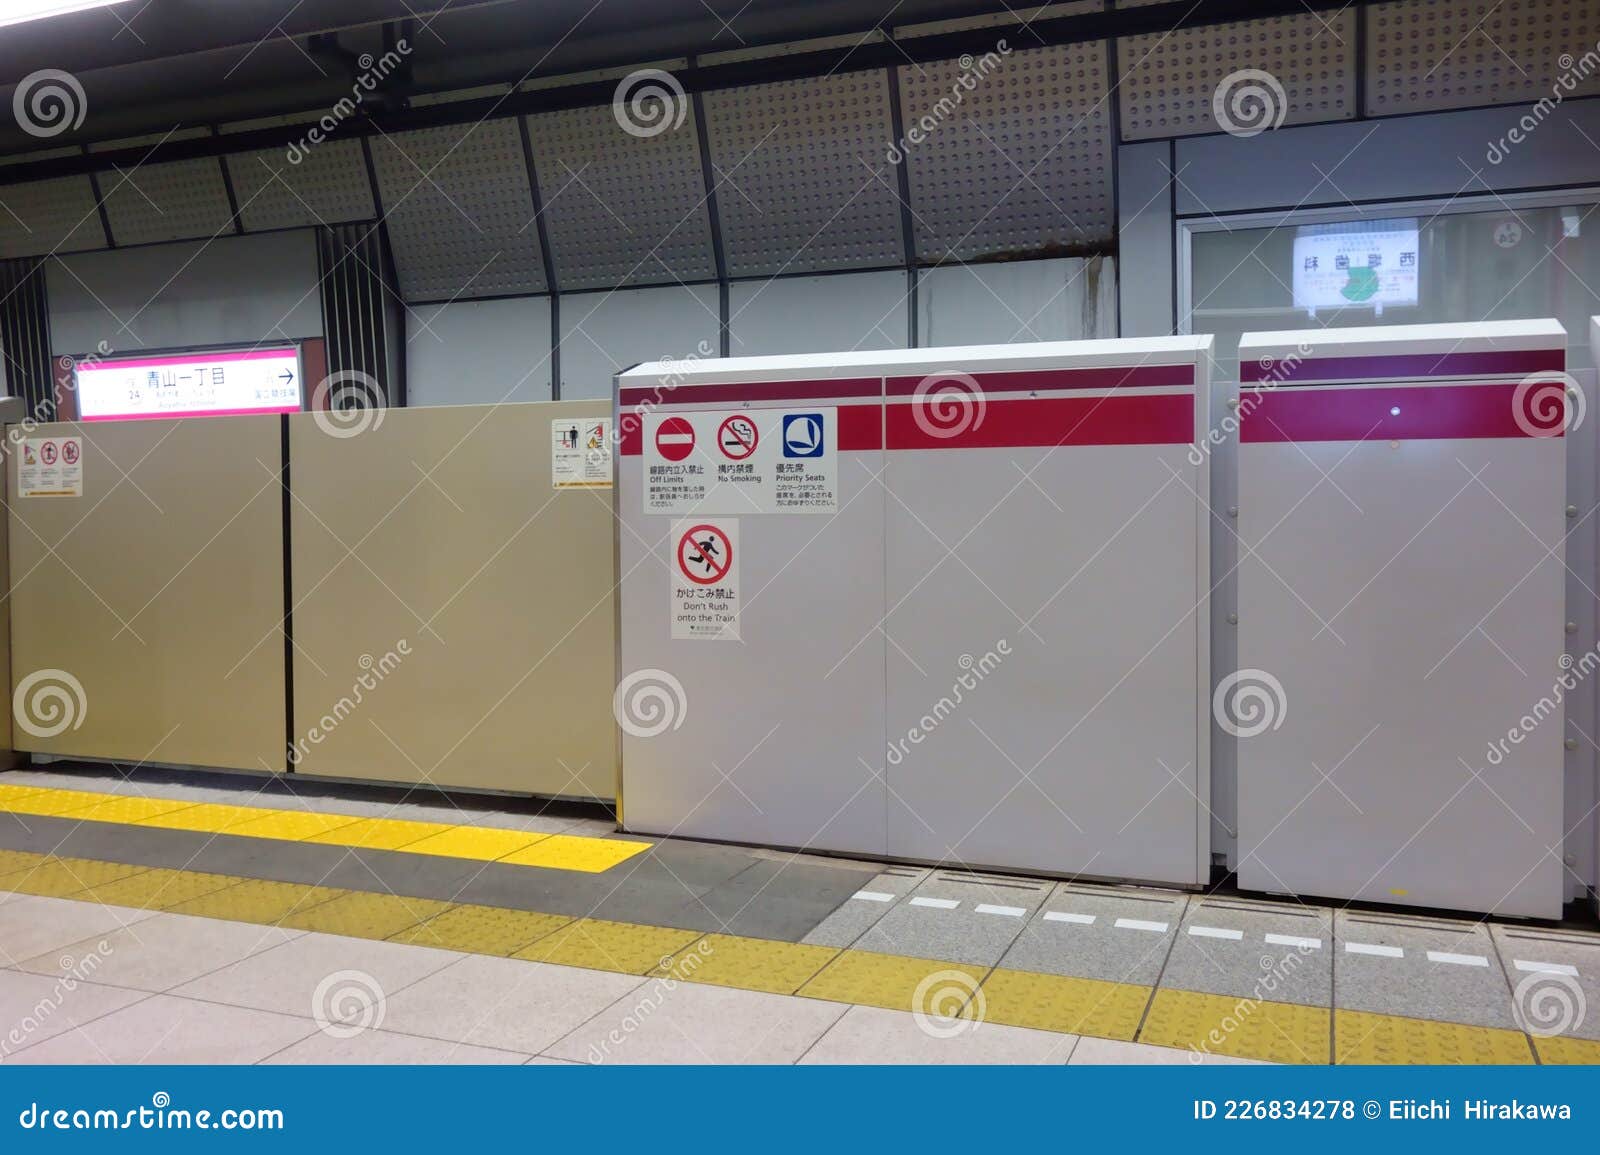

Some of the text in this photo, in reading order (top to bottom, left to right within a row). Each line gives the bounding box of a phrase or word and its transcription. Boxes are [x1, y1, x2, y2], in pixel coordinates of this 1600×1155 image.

[146, 367, 225, 389] 青山一丁目
[650, 464, 704, 475] 線路内立入禁止
[718, 463, 754, 474] 構内禁煙
[775, 463, 804, 473] 優先席
[650, 475, 684, 483] Off Limits
[731, 475, 762, 483] Smoking
[775, 474, 825, 483] Priority Seats
[676, 588, 736, 599] かけこみ禁止
[683, 602, 729, 611] Don't Rush
[677, 613, 736, 622] onto the Train
